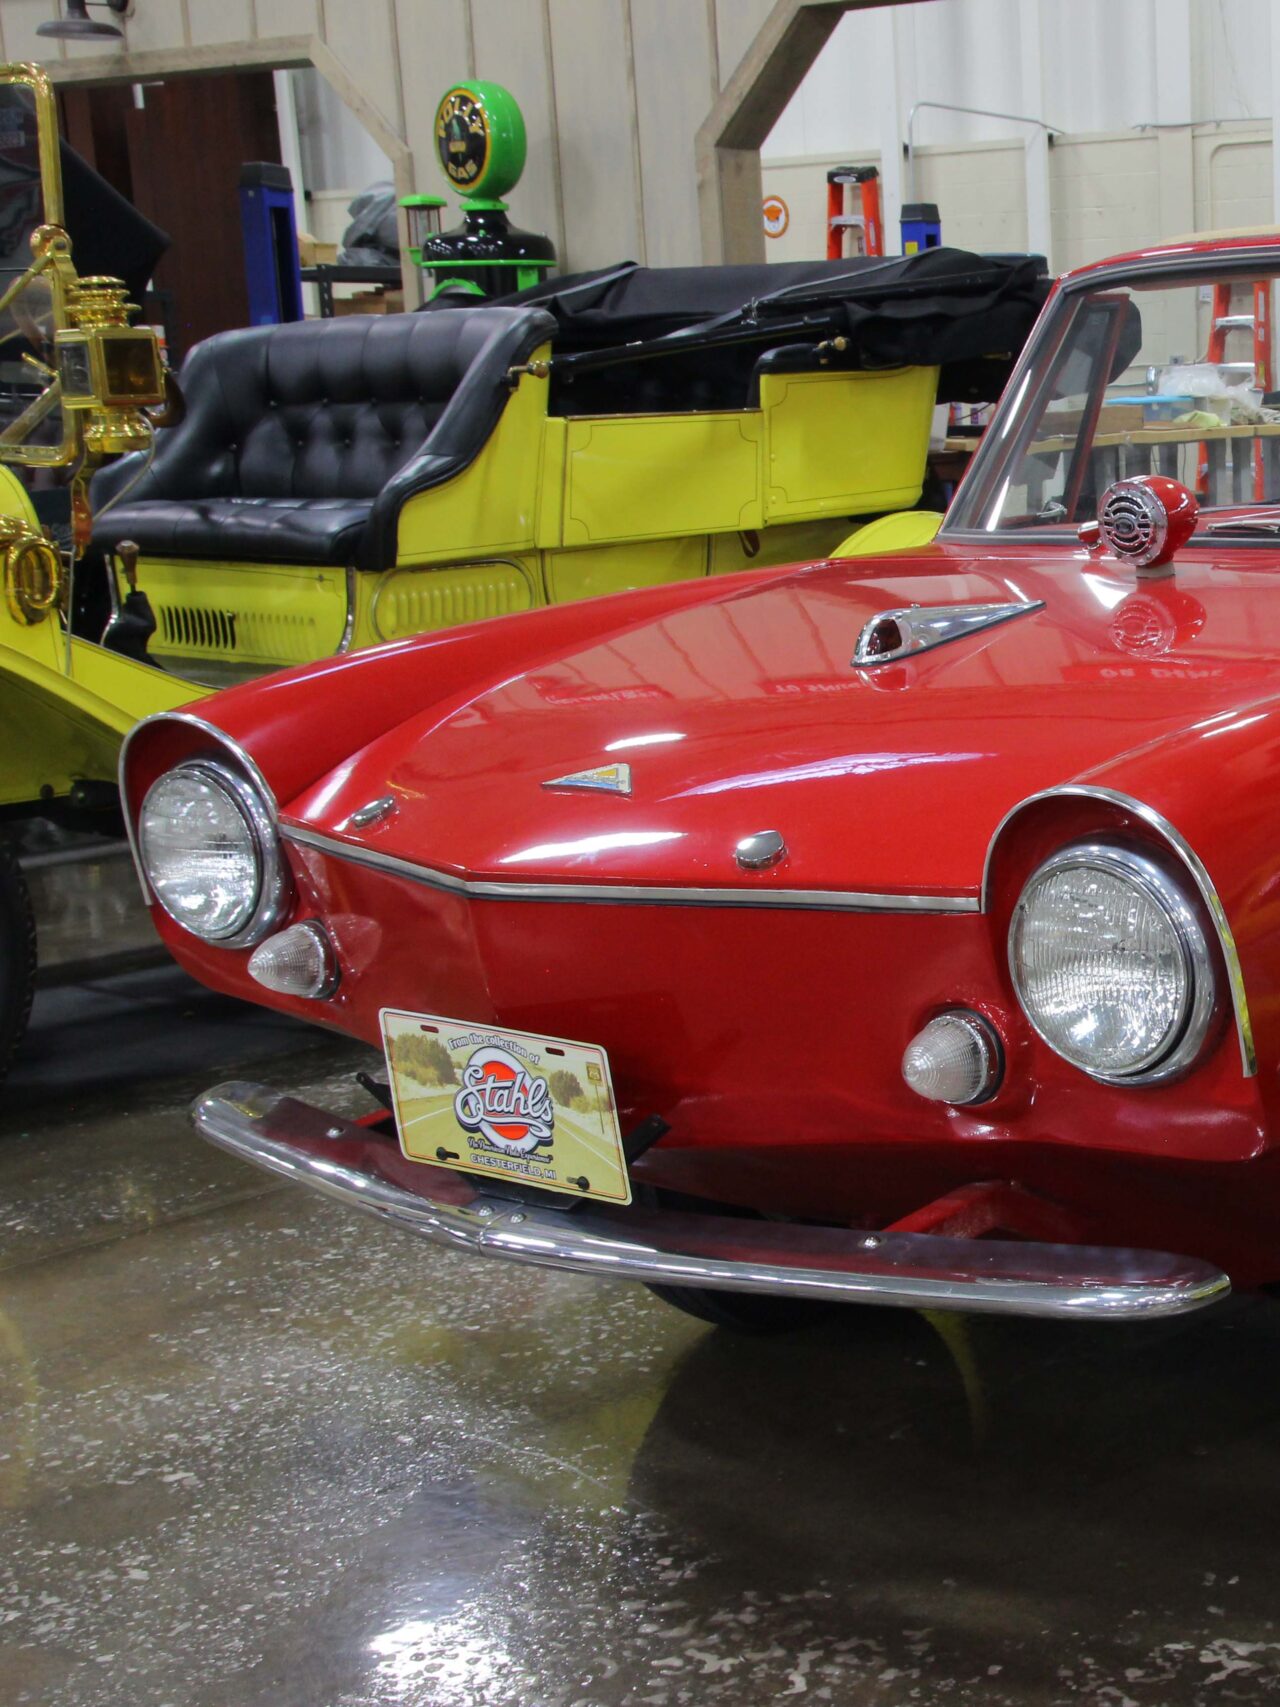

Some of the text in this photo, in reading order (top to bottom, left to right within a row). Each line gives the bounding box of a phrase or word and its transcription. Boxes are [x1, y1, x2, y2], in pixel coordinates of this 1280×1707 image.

[438, 96, 486, 138] POLLY
[447, 159, 478, 180] GAS
[448, 1033, 541, 1065] From the collection of
[454, 1064, 553, 1138] Stahls
[470, 1153, 557, 1180] CHESTERFIELD, MI
